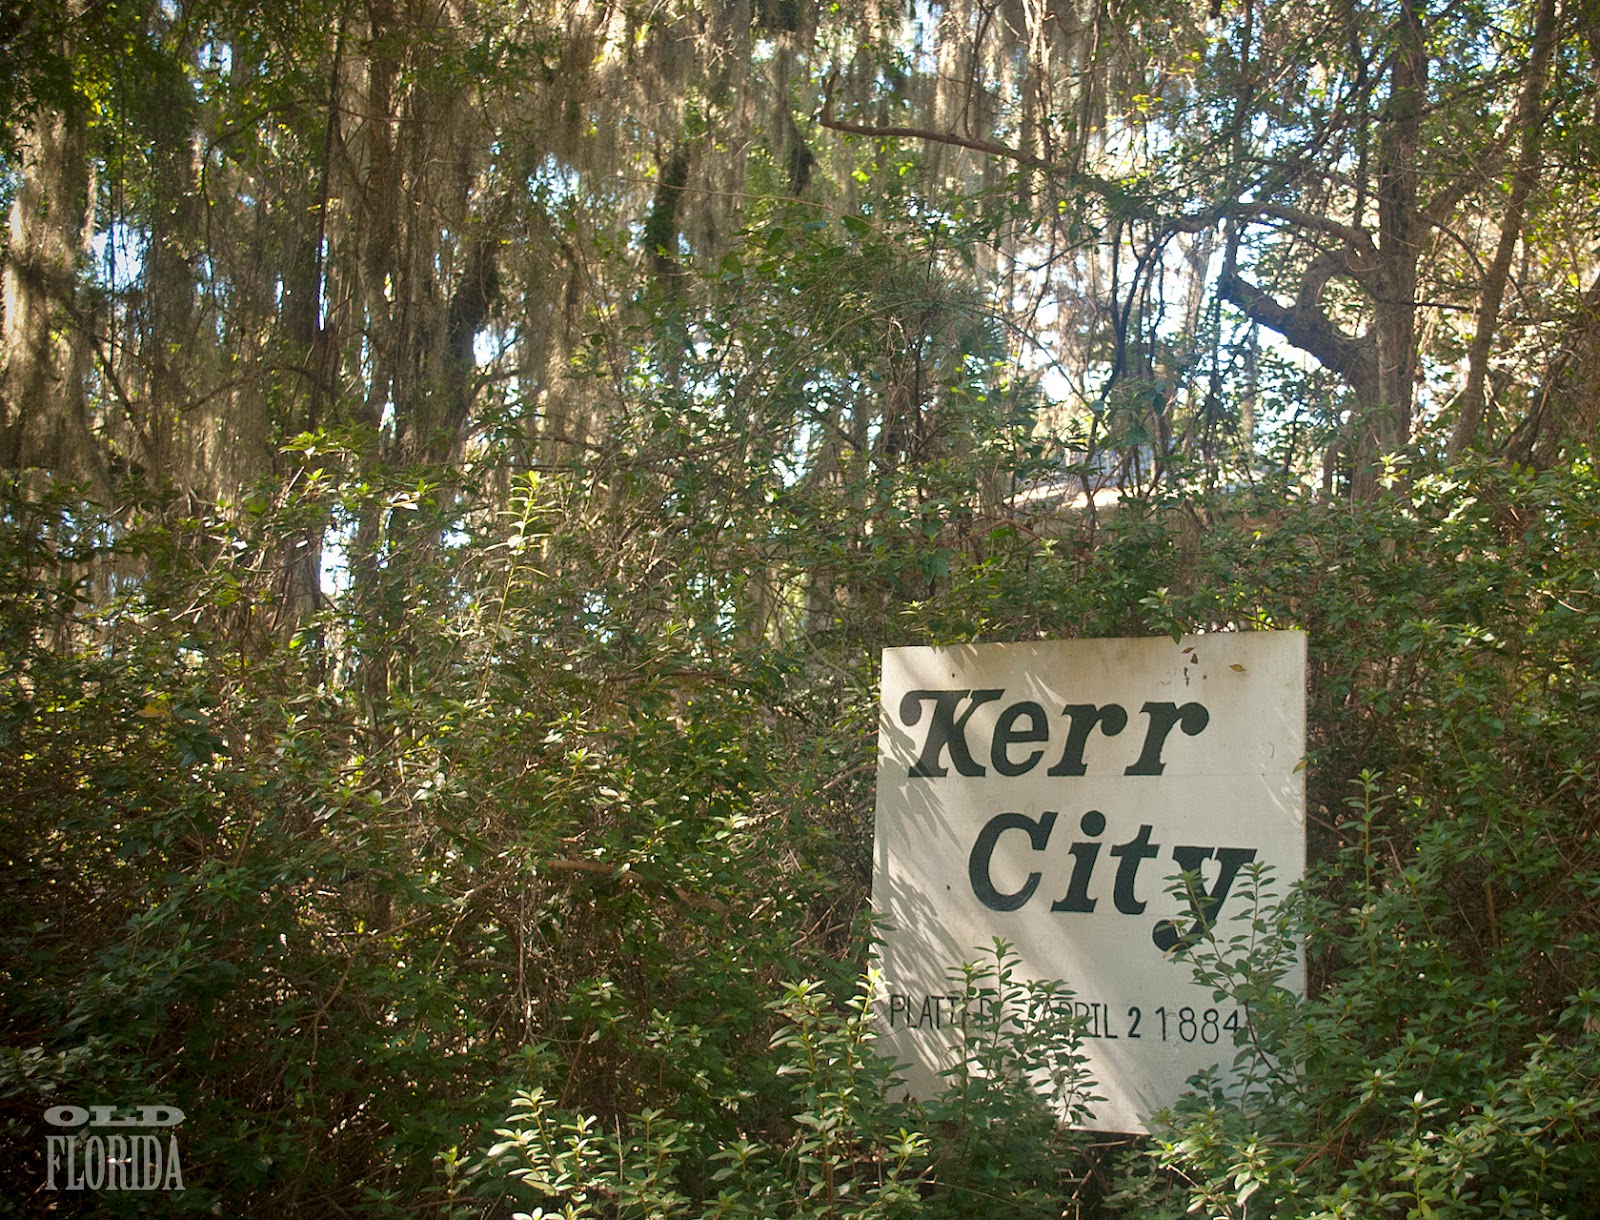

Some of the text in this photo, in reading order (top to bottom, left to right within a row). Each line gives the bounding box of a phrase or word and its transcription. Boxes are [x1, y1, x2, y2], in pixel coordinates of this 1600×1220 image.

[900, 689, 1210, 778] Kerr
[968, 810, 1258, 952] City
[1040, 1001, 1118, 1039] PRIL
[1127, 1006, 1141, 1038] 2
[1155, 1006, 1242, 1048] 1884
